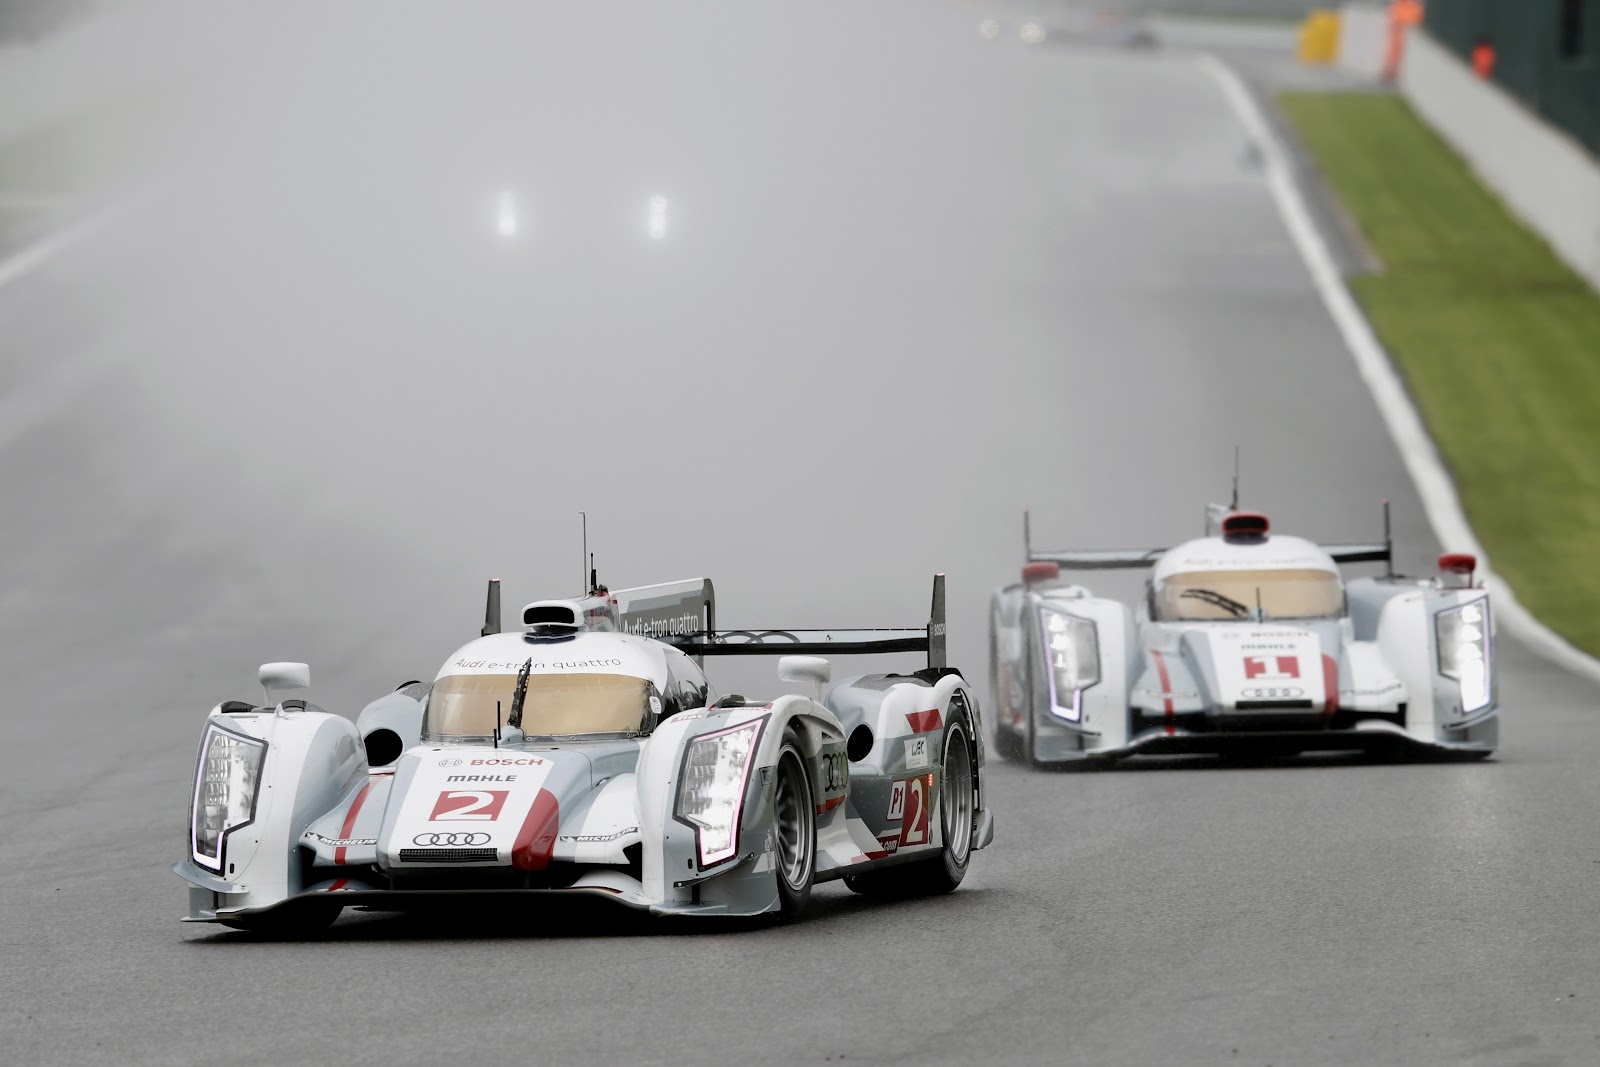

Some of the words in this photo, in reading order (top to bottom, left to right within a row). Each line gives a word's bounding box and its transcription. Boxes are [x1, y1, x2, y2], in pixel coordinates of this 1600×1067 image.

[453, 658, 486, 668] Audi
[552, 658, 622, 669] quattro
[1251, 656, 1292, 678] 1
[434, 791, 495, 821] 2
[891, 787, 904, 814] P1
[906, 778, 924, 843] 2
[320, 837, 377, 846] MICHELIN
[576, 826, 636, 841] MICHELIN
